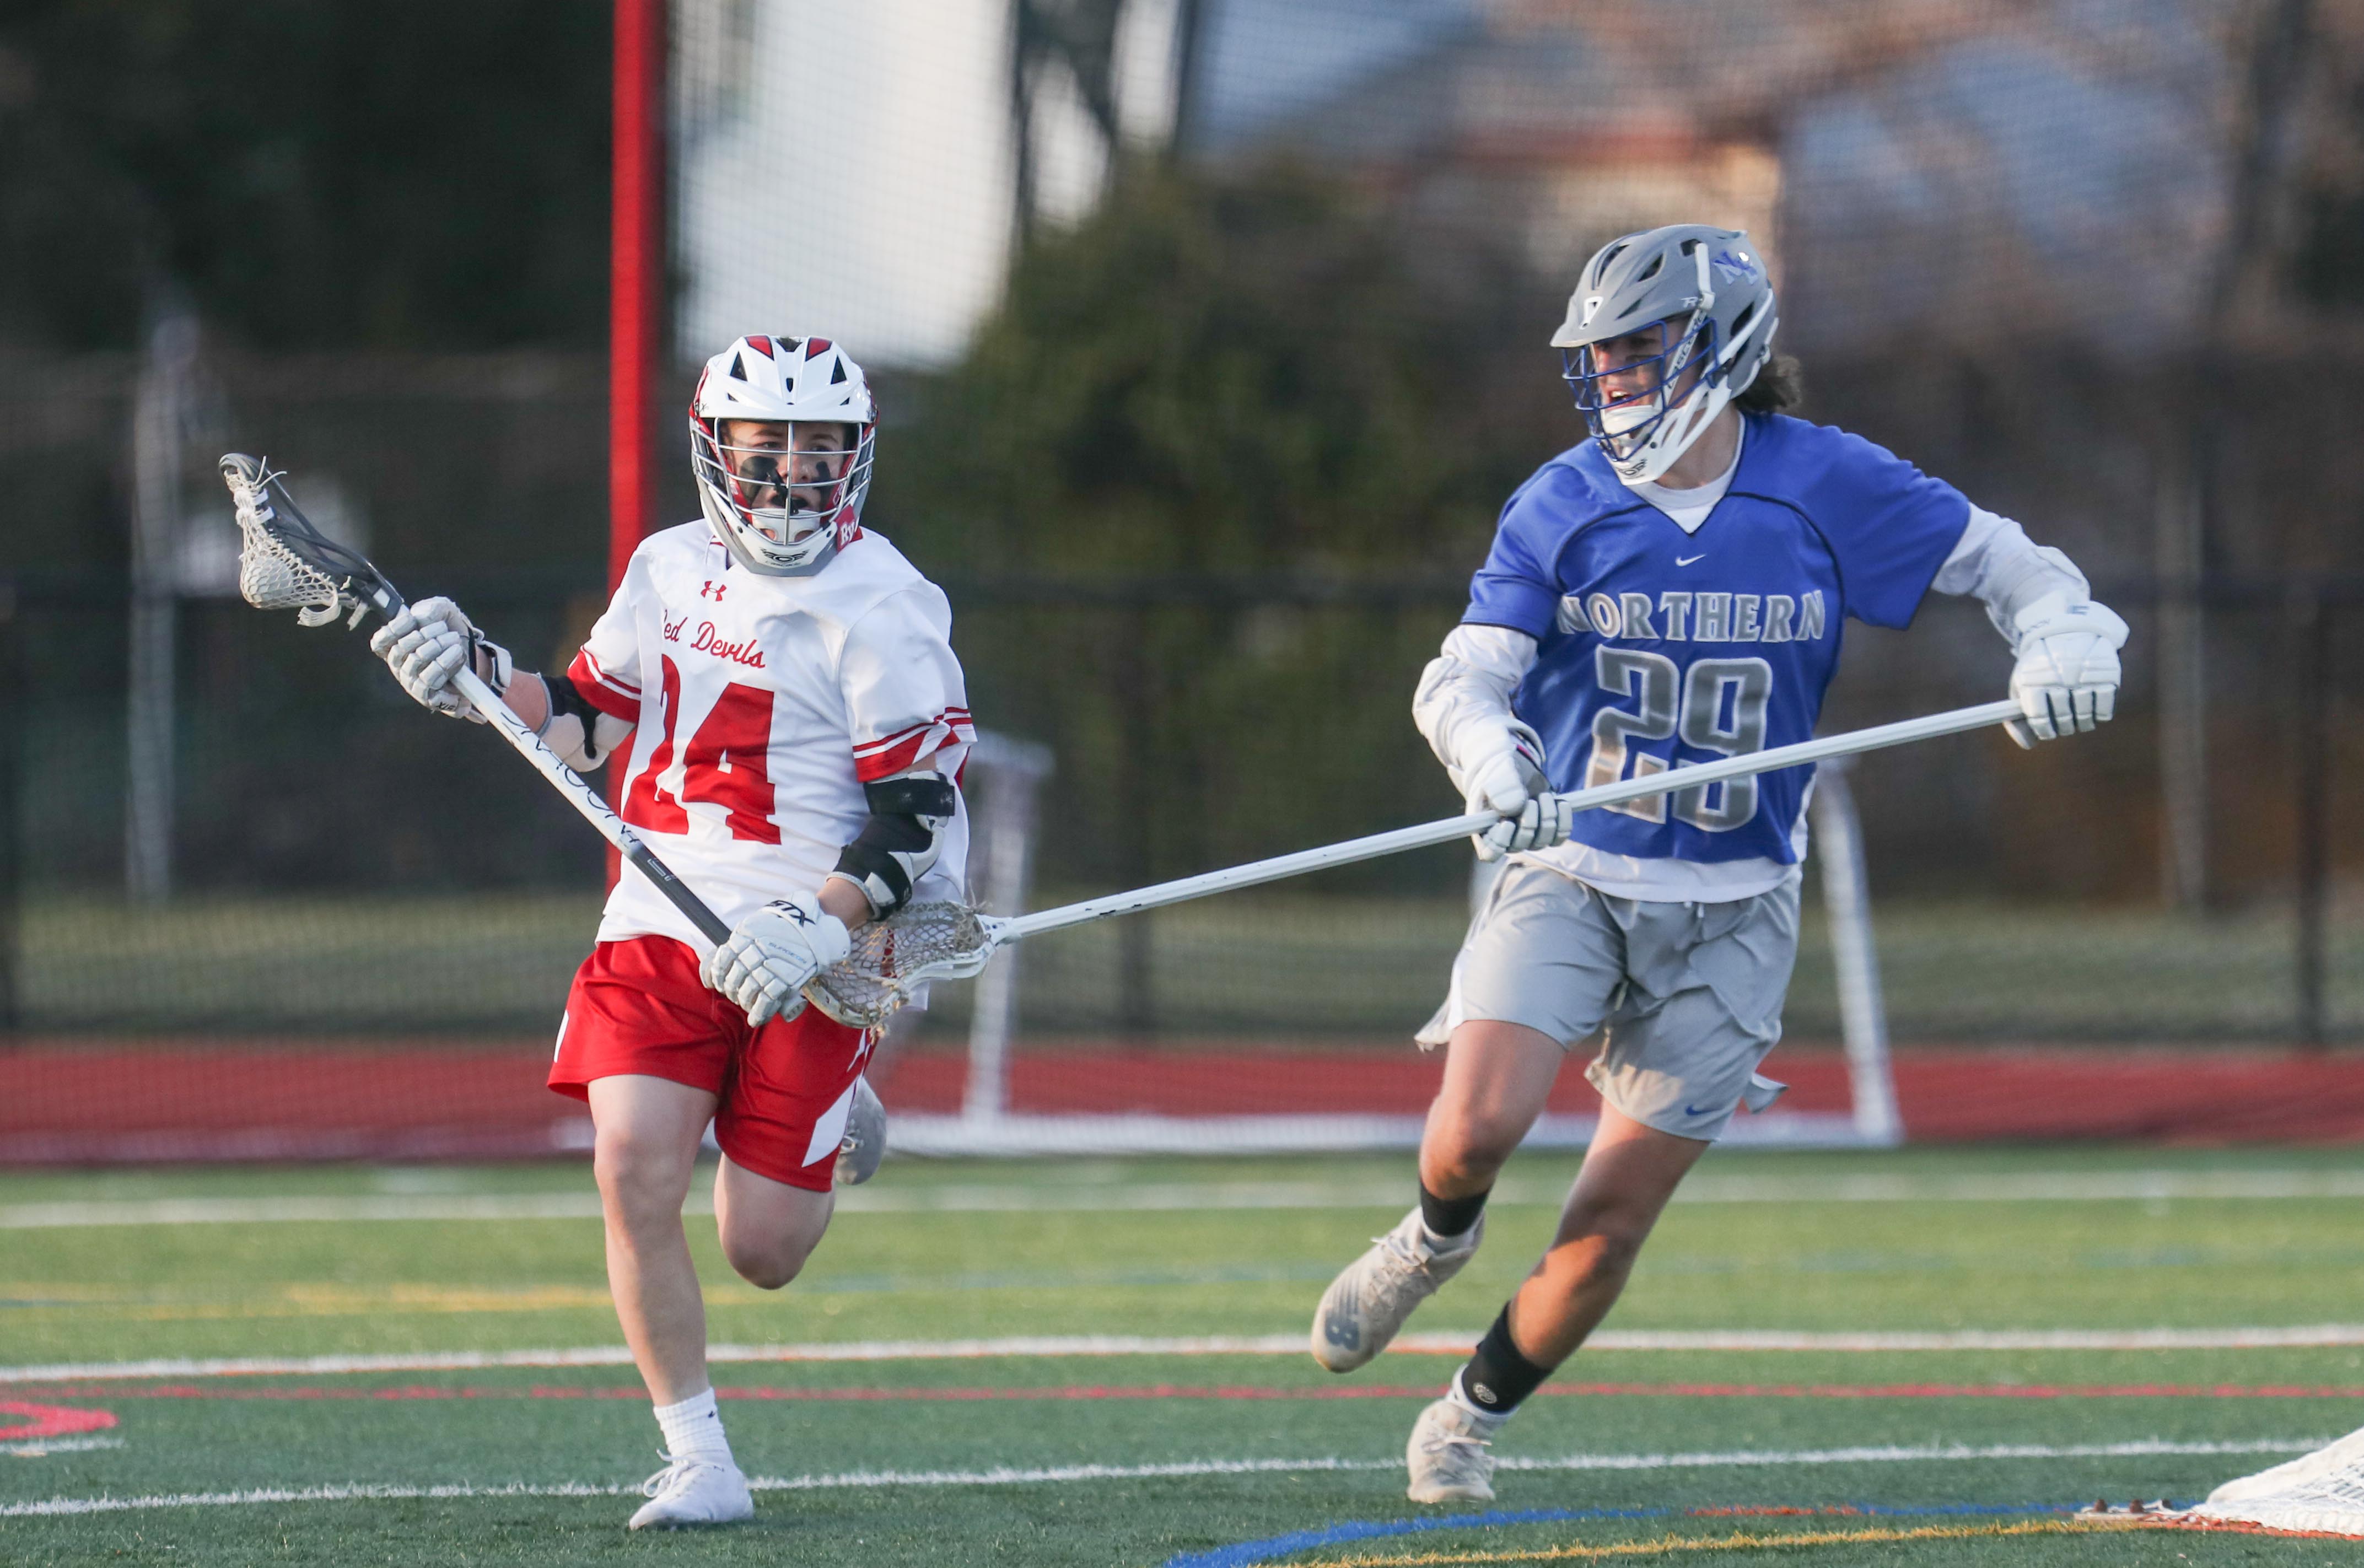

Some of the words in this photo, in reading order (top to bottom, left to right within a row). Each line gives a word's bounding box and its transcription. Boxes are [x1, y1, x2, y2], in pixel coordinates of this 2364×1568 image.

[663, 608, 688, 643] ed
[690, 621, 766, 668] Devils
[1557, 590, 1825, 643] NORTHERN
[622, 653, 782, 845] 24
[1585, 643, 1773, 833] 29
